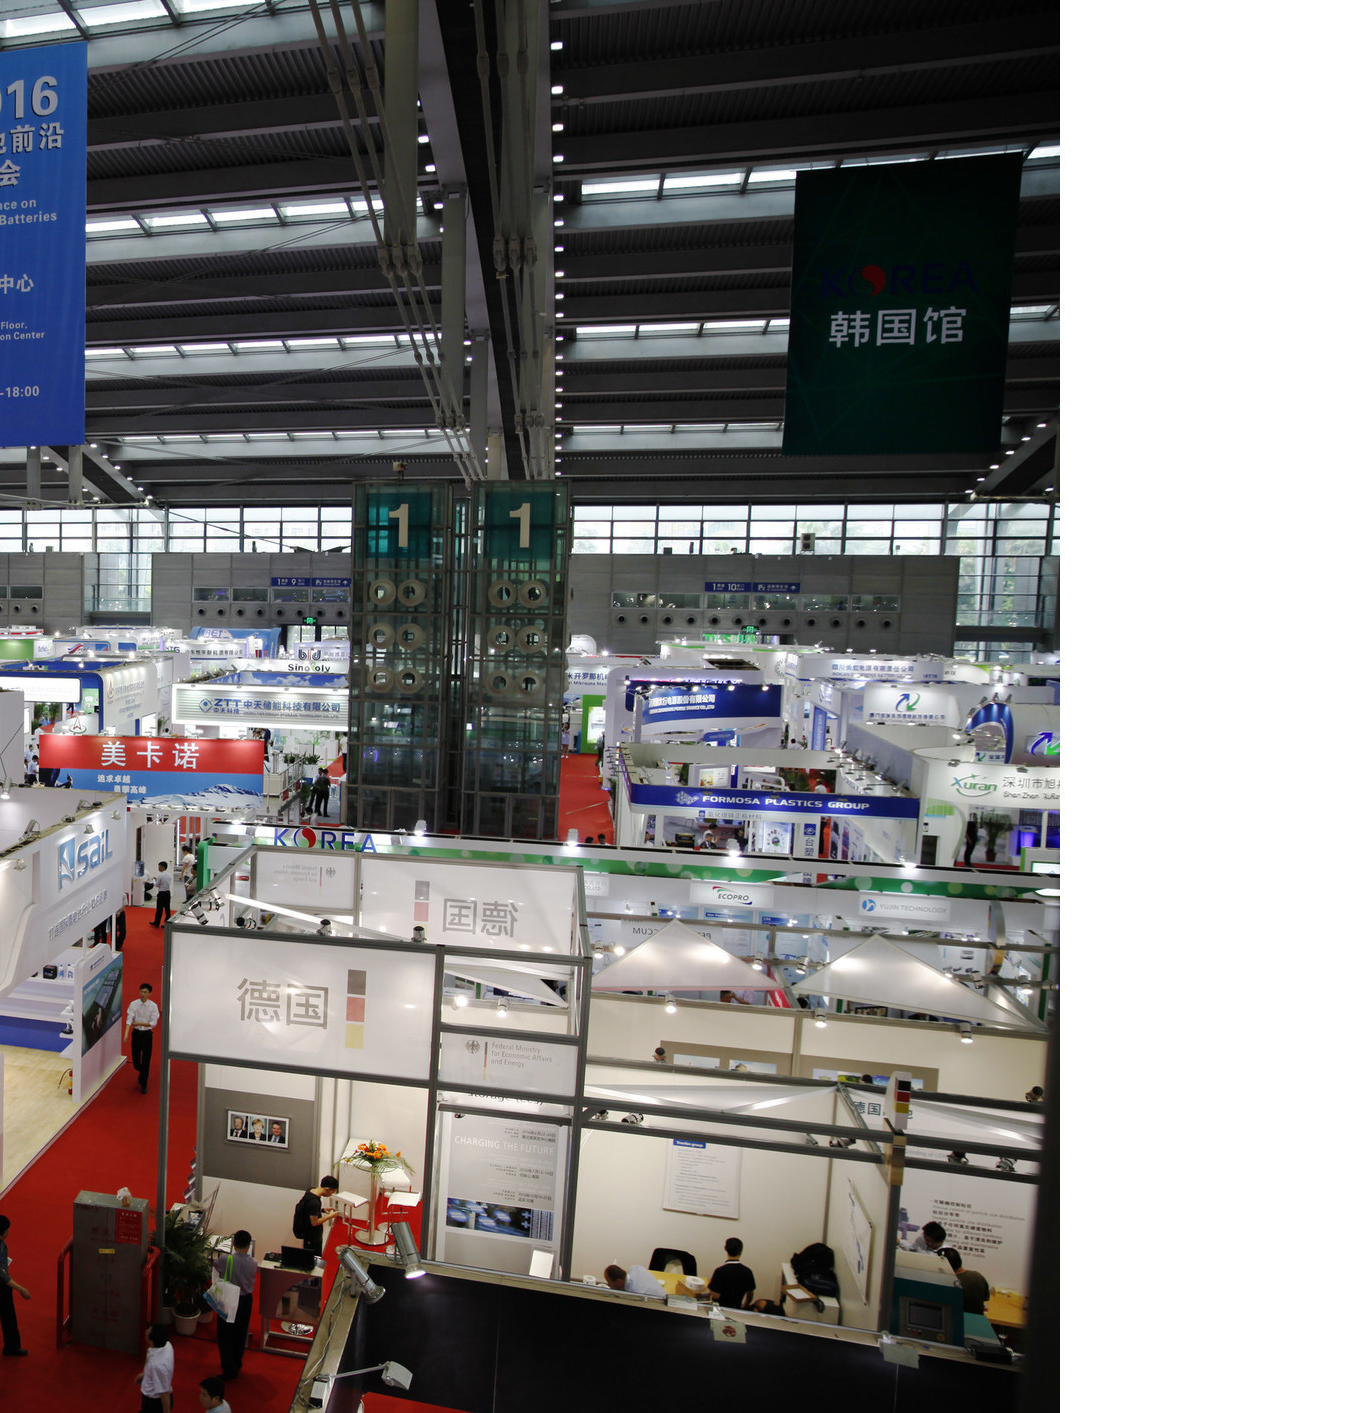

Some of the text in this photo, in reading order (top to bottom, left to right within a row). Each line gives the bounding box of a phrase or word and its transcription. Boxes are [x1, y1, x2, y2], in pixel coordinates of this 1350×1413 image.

[21, 199, 37, 209] on
[0, 211, 58, 226] Batteries
[821, 261, 978, 299] KOREA
[1, 320, 28, 330] Floor,
[828, 305, 967, 348] 韩国馆
[13, 330, 45, 340] Center
[388, 503, 410, 548] 1
[509, 502, 531, 548] 1
[213, 698, 242, 707] ZTT
[100, 740, 201, 770] 美卡诺
[1002, 776, 1060, 790] 深圳市旭
[702, 795, 870, 810] FORMOSA PLASTICS GROUP
[274, 828, 377, 854] KOREA
[717, 892, 750, 903] ECOPRO
[900, 905, 948, 914] TECHNOLOGY
[237, 977, 329, 1030] 德国
[491, 1041, 541, 1055] Federal Ministry
[491, 1050, 553, 1063] for Economic Affairs
[491, 1058, 525, 1069] and Energy
[454, 1135, 555, 1156] CHARGING THE FUTURE
